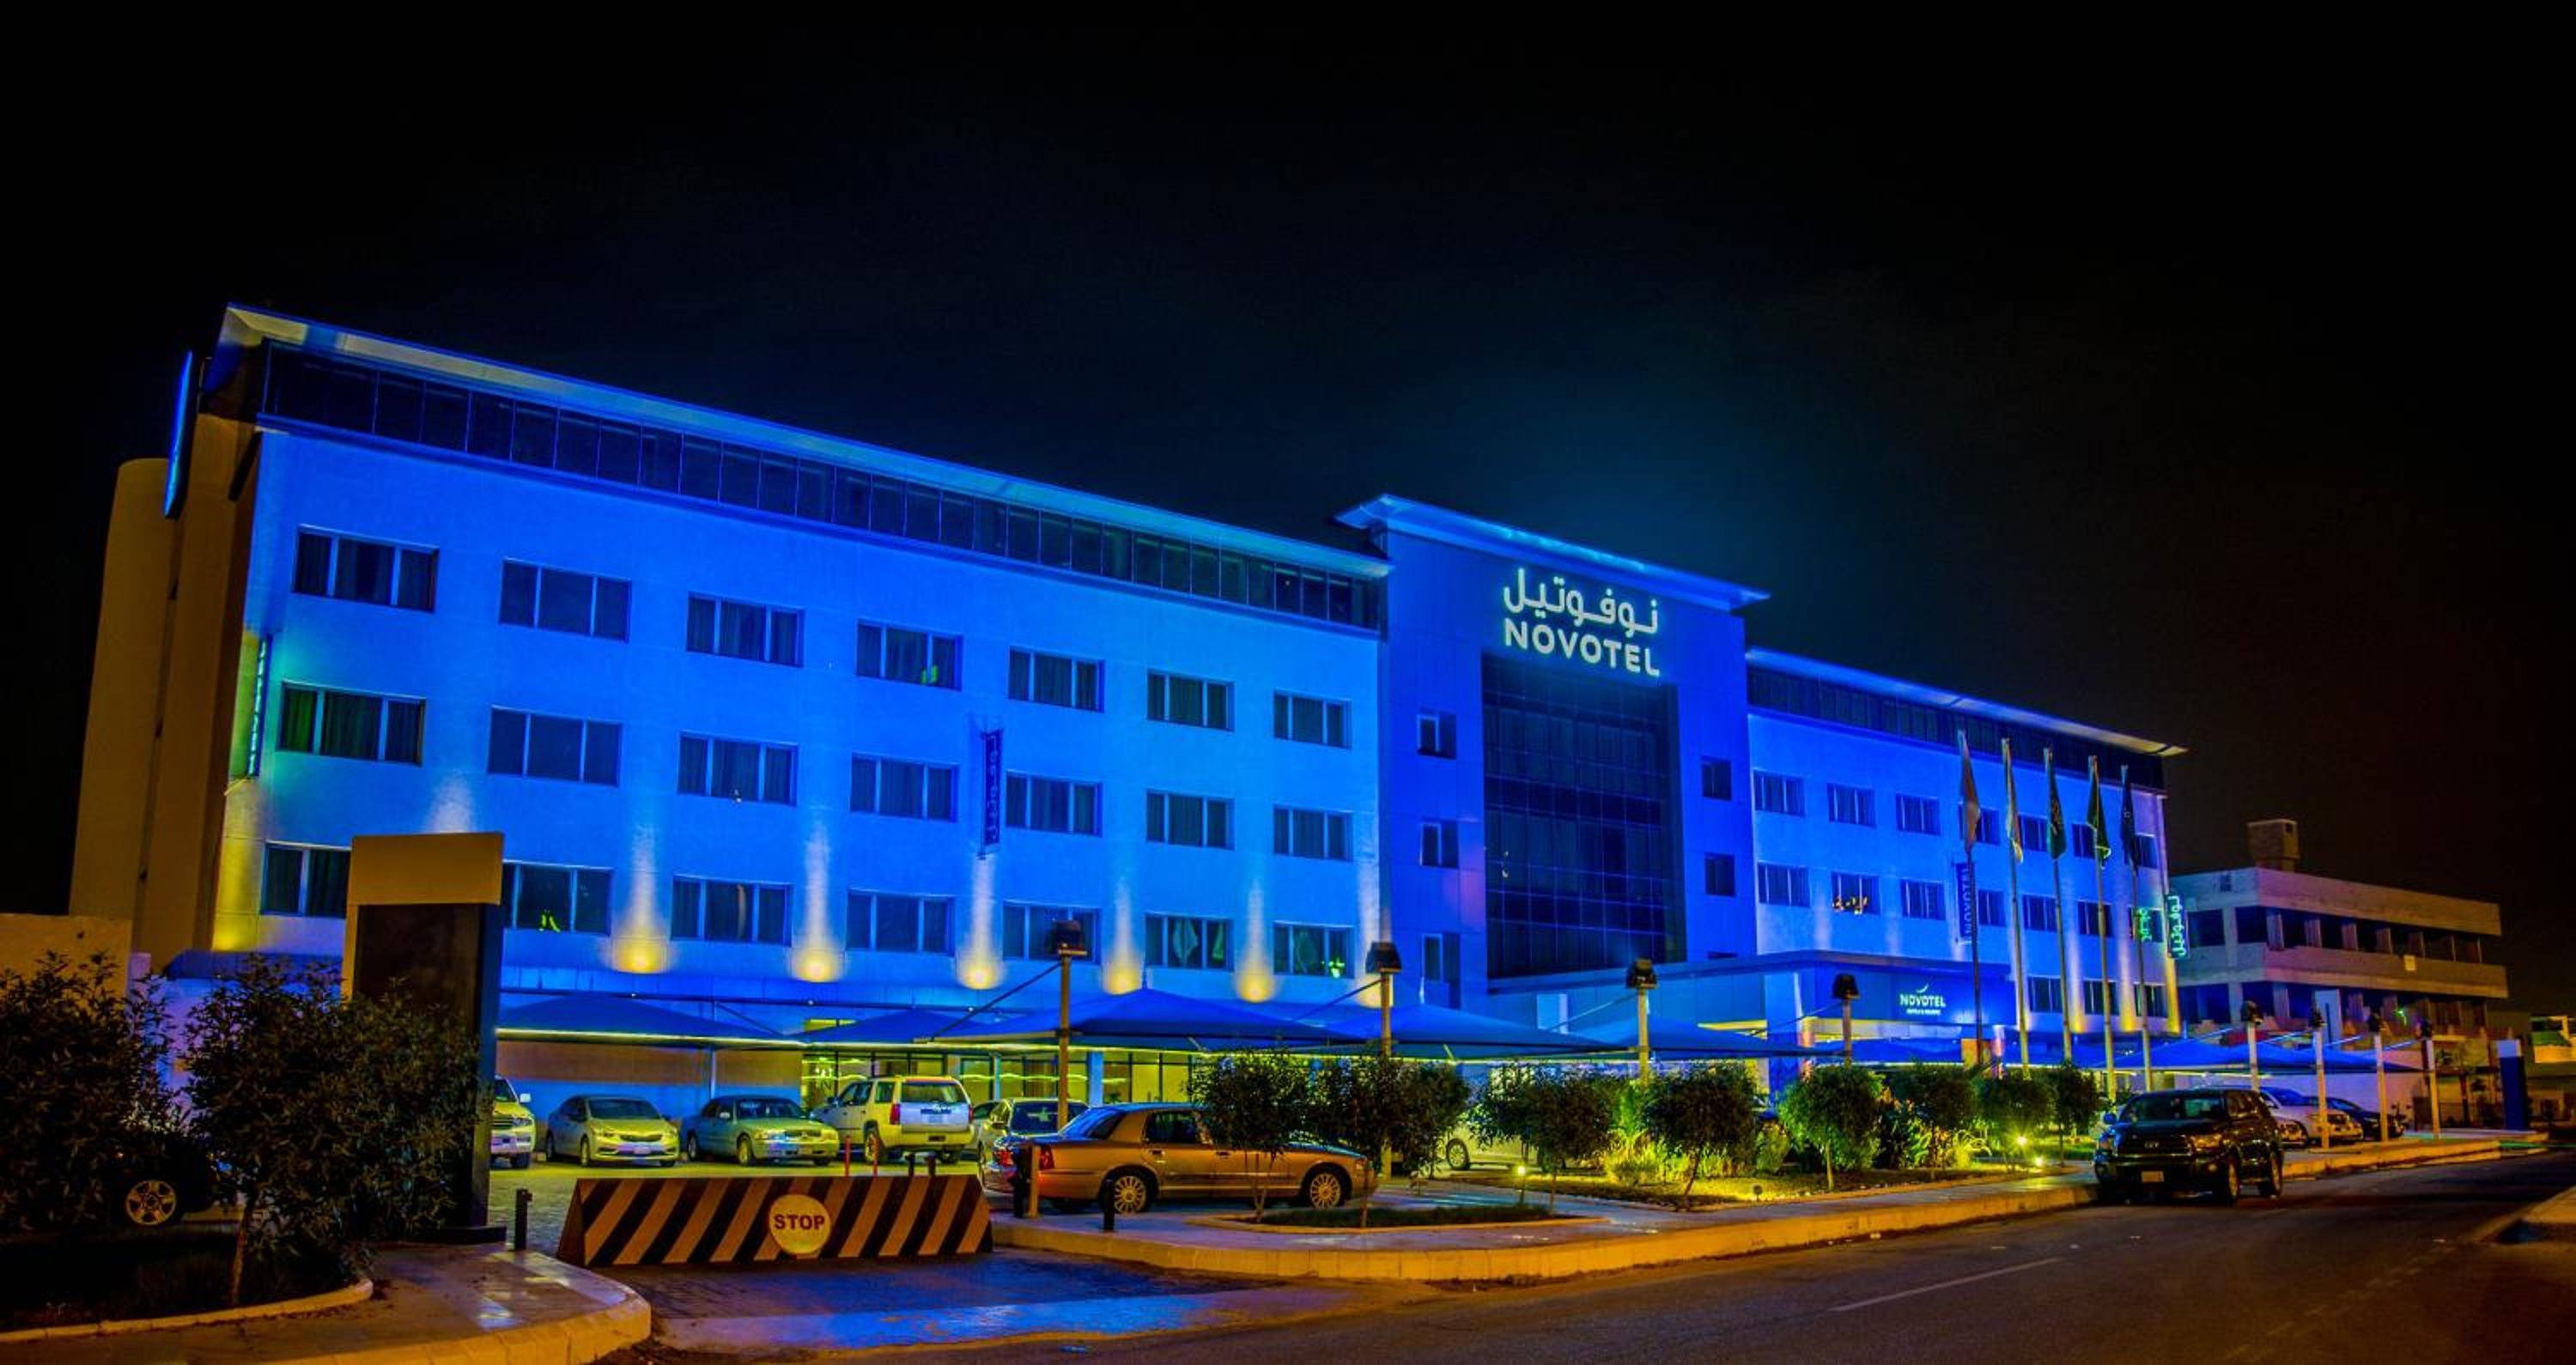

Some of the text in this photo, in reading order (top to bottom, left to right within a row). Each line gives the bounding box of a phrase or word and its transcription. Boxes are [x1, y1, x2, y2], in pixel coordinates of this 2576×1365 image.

[1504, 567, 1658, 638] نوفوتيل
[1504, 618, 1660, 676] NOVOTEL
[1899, 994, 1946, 1008] NOVOTEL
[774, 1214, 825, 1230] STOP
